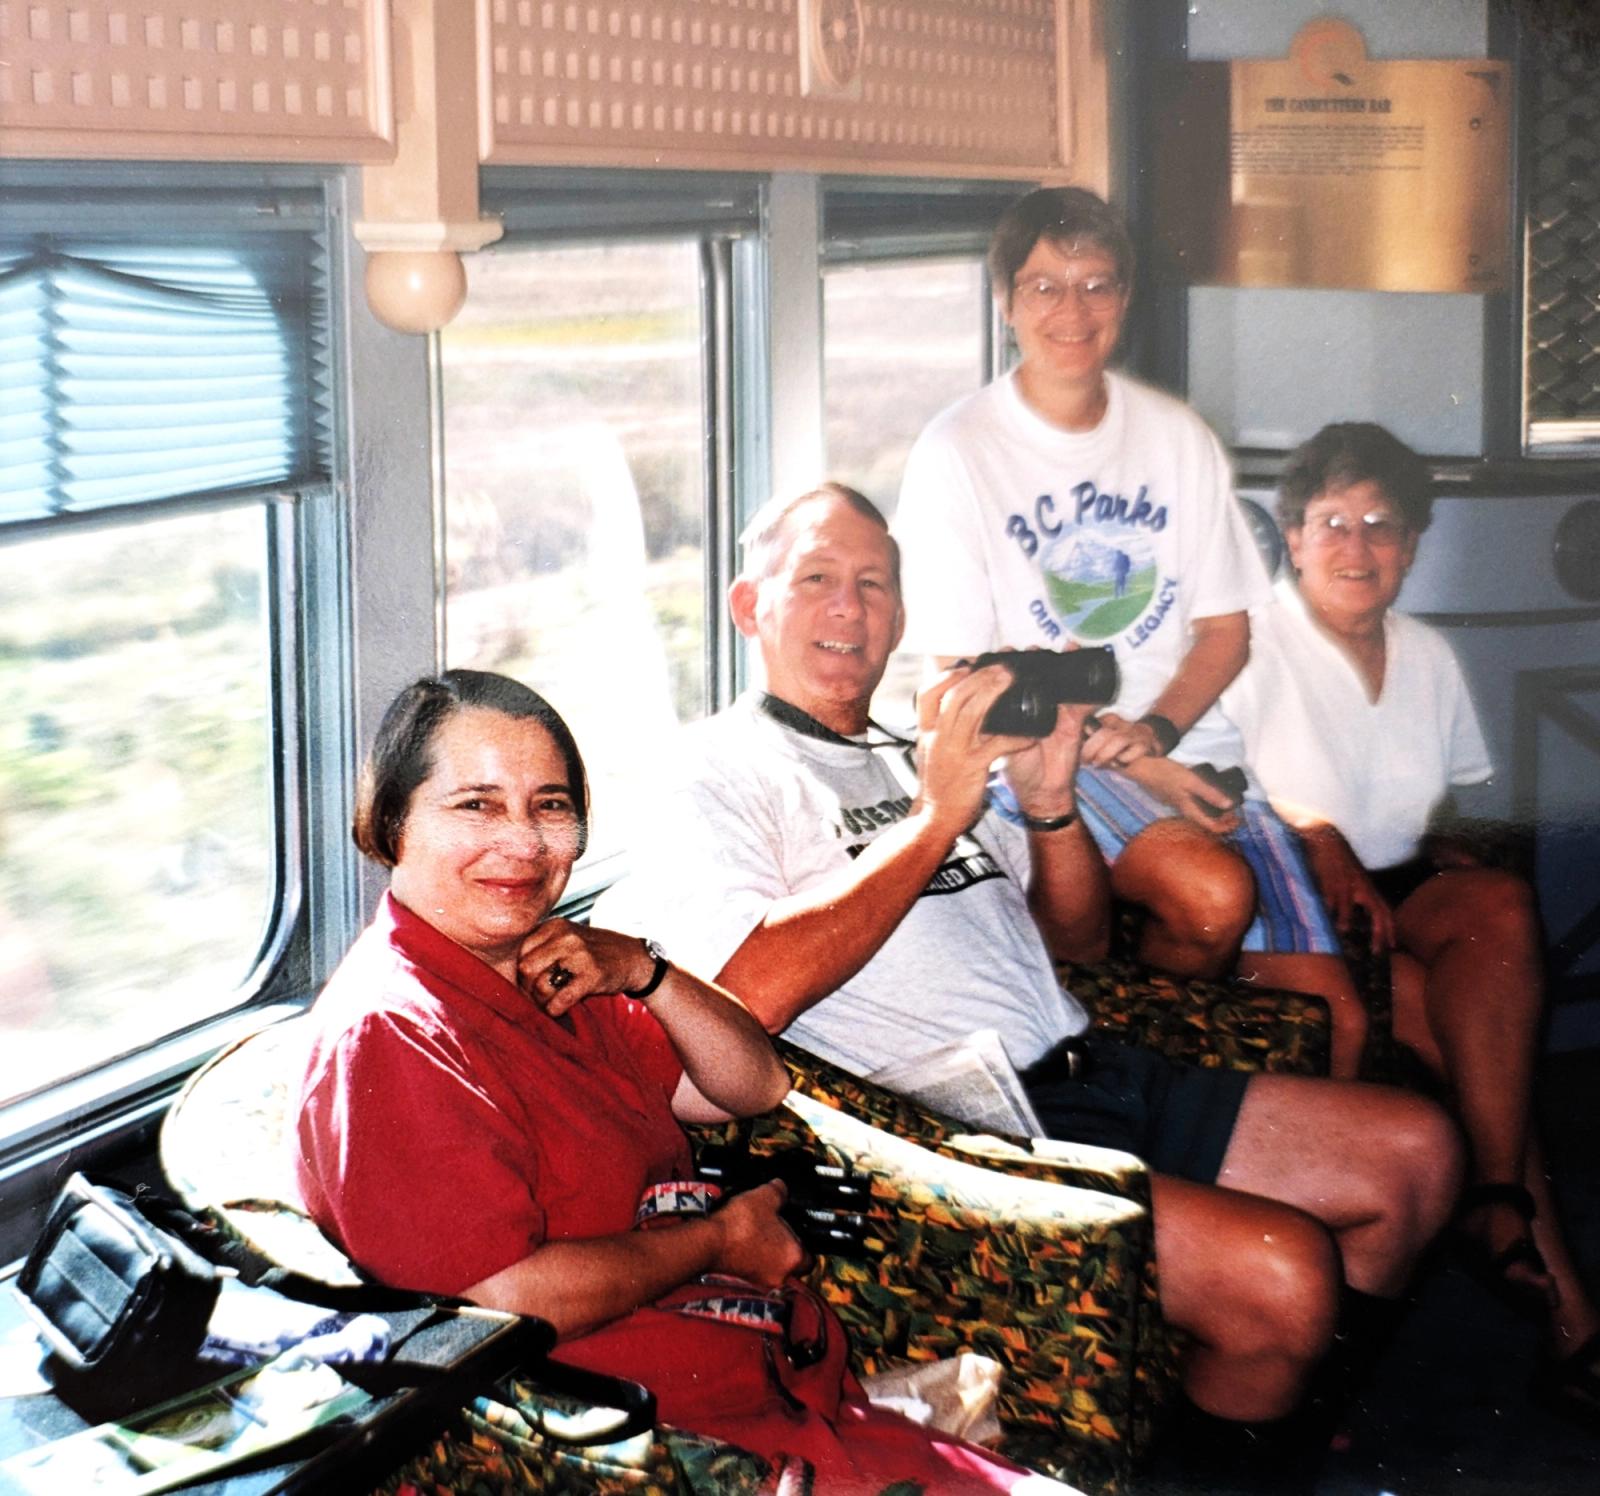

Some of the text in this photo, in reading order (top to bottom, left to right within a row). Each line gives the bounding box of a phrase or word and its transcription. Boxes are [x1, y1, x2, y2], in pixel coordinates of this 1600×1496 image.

[1070, 481, 1168, 533] Parks
[1029, 576, 1179, 650] OUR LEGACY
